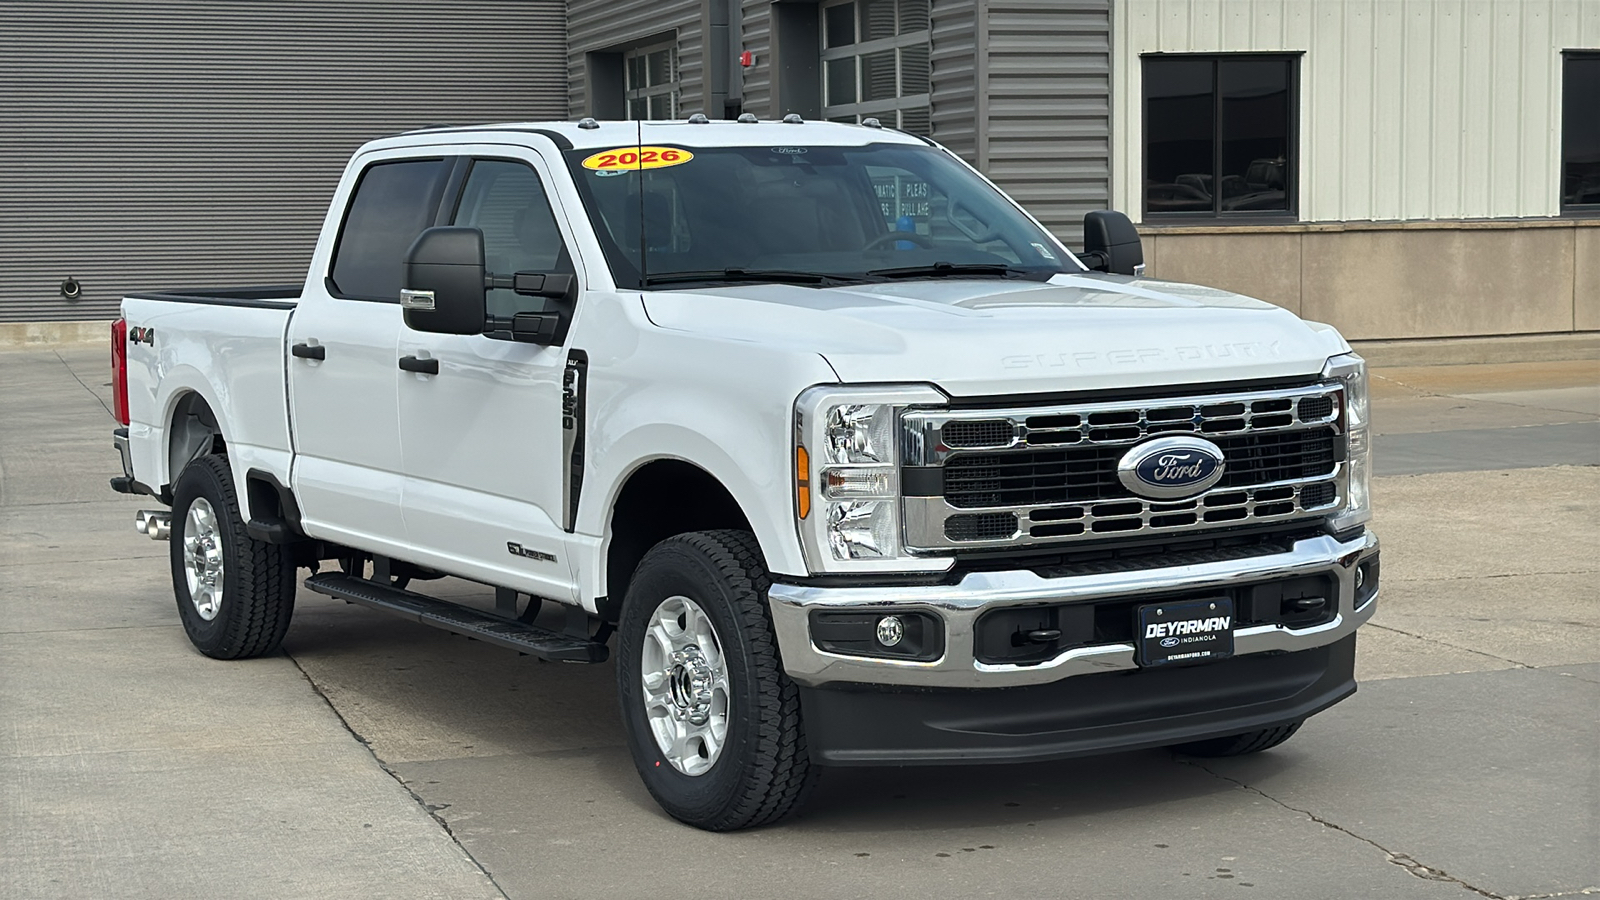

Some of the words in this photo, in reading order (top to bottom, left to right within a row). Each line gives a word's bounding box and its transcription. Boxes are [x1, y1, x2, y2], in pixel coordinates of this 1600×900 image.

[598, 150, 680, 168] 2026
[1001, 348, 1170, 369] SUPER
[1174, 340, 1281, 360] DUTY
[1154, 454, 1203, 481] Ford
[1145, 616, 1231, 639] DEYARMAN
[1181, 634, 1217, 644] INDIANOLA
[1167, 651, 1211, 661] DEYARMANFORD.COM
